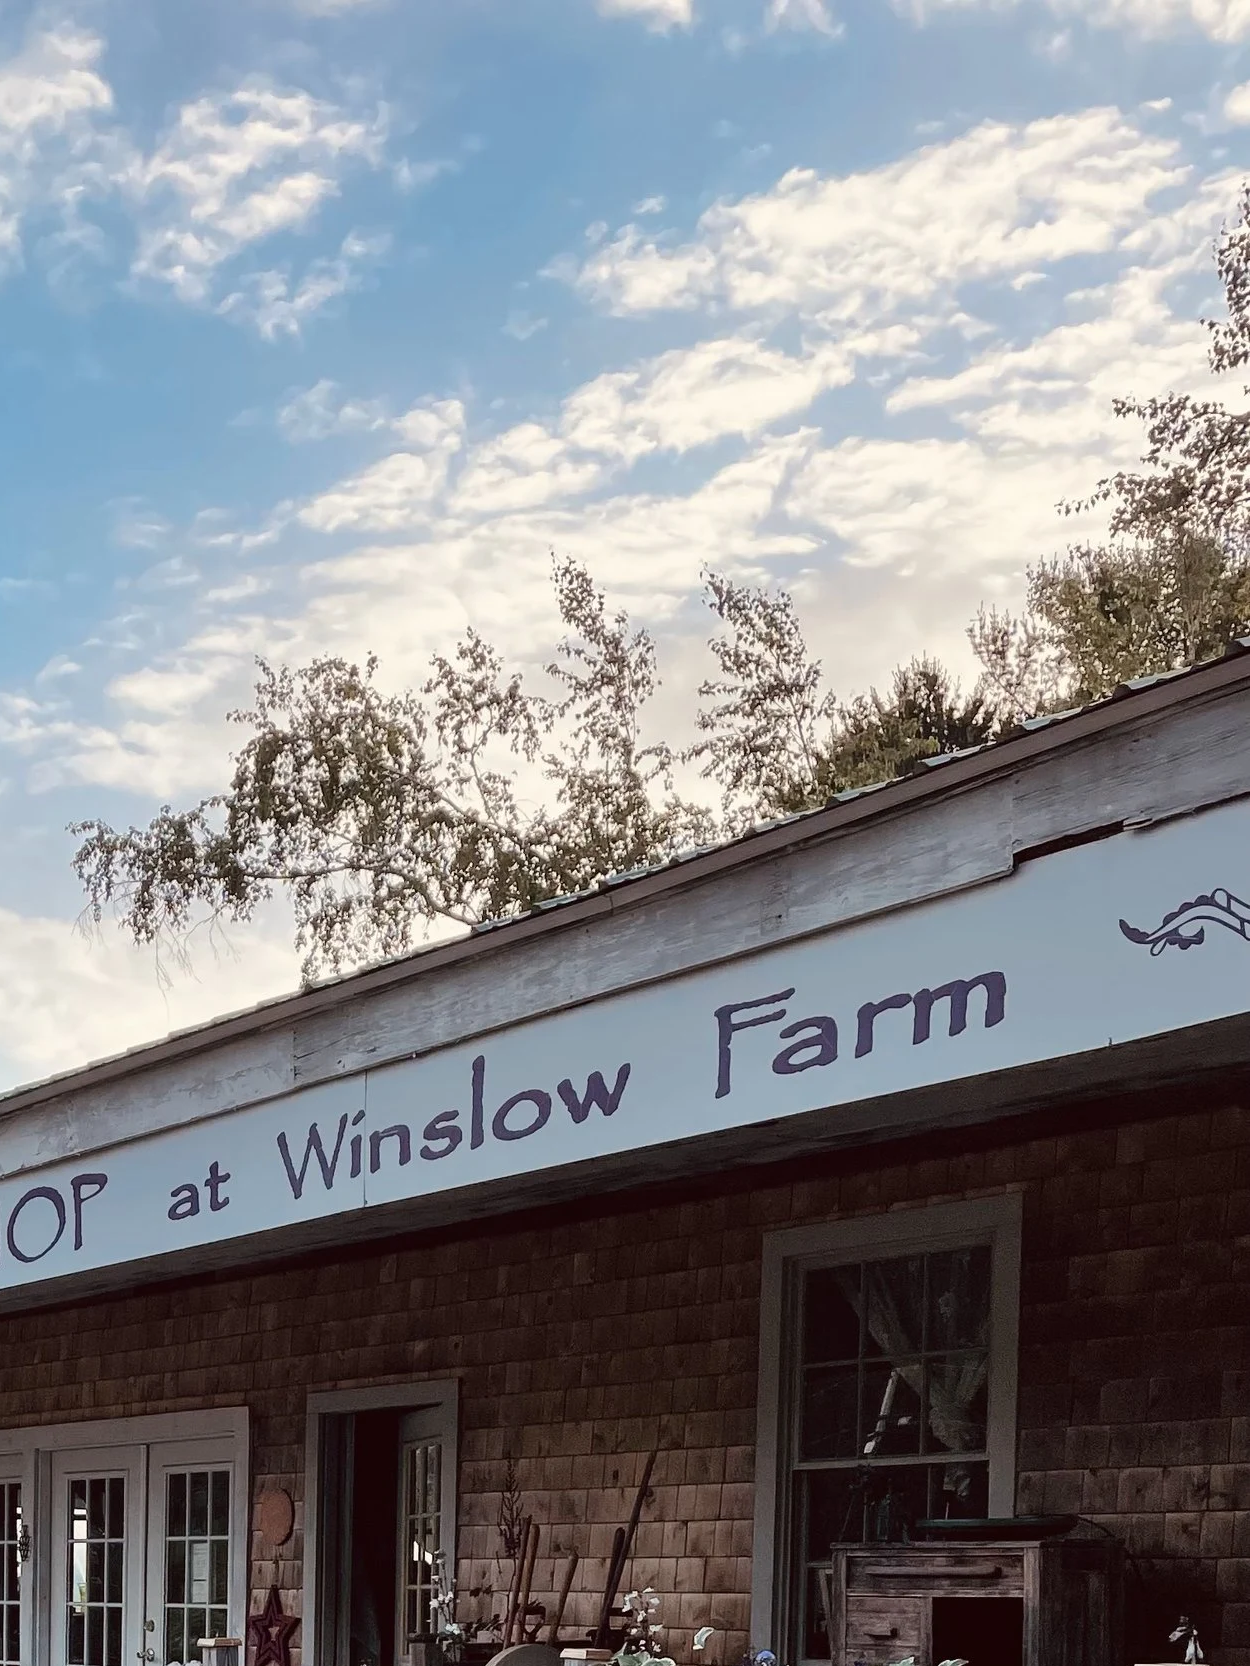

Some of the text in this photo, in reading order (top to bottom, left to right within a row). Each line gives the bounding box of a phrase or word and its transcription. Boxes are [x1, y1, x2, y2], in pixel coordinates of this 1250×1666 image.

[168, 1161, 231, 1221] at
[276, 1054, 631, 1200] Winslow
[715, 971, 1006, 1100] Farm
